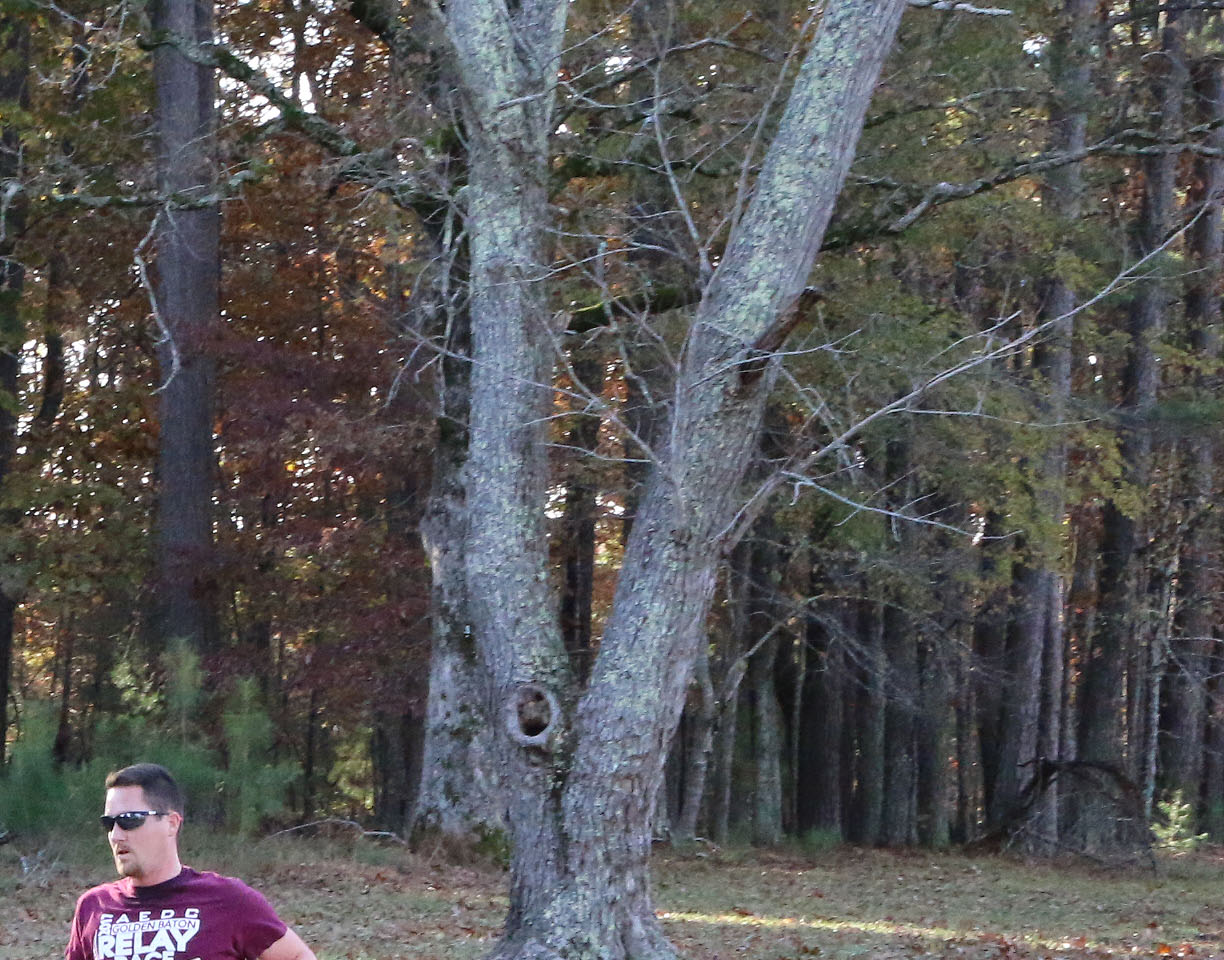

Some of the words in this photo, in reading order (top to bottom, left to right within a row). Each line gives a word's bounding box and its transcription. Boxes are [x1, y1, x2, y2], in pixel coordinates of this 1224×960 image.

[112, 921, 155, 934] GOLDEN
[158, 919, 196, 929] BATON
[98, 926, 200, 959] RELAY
